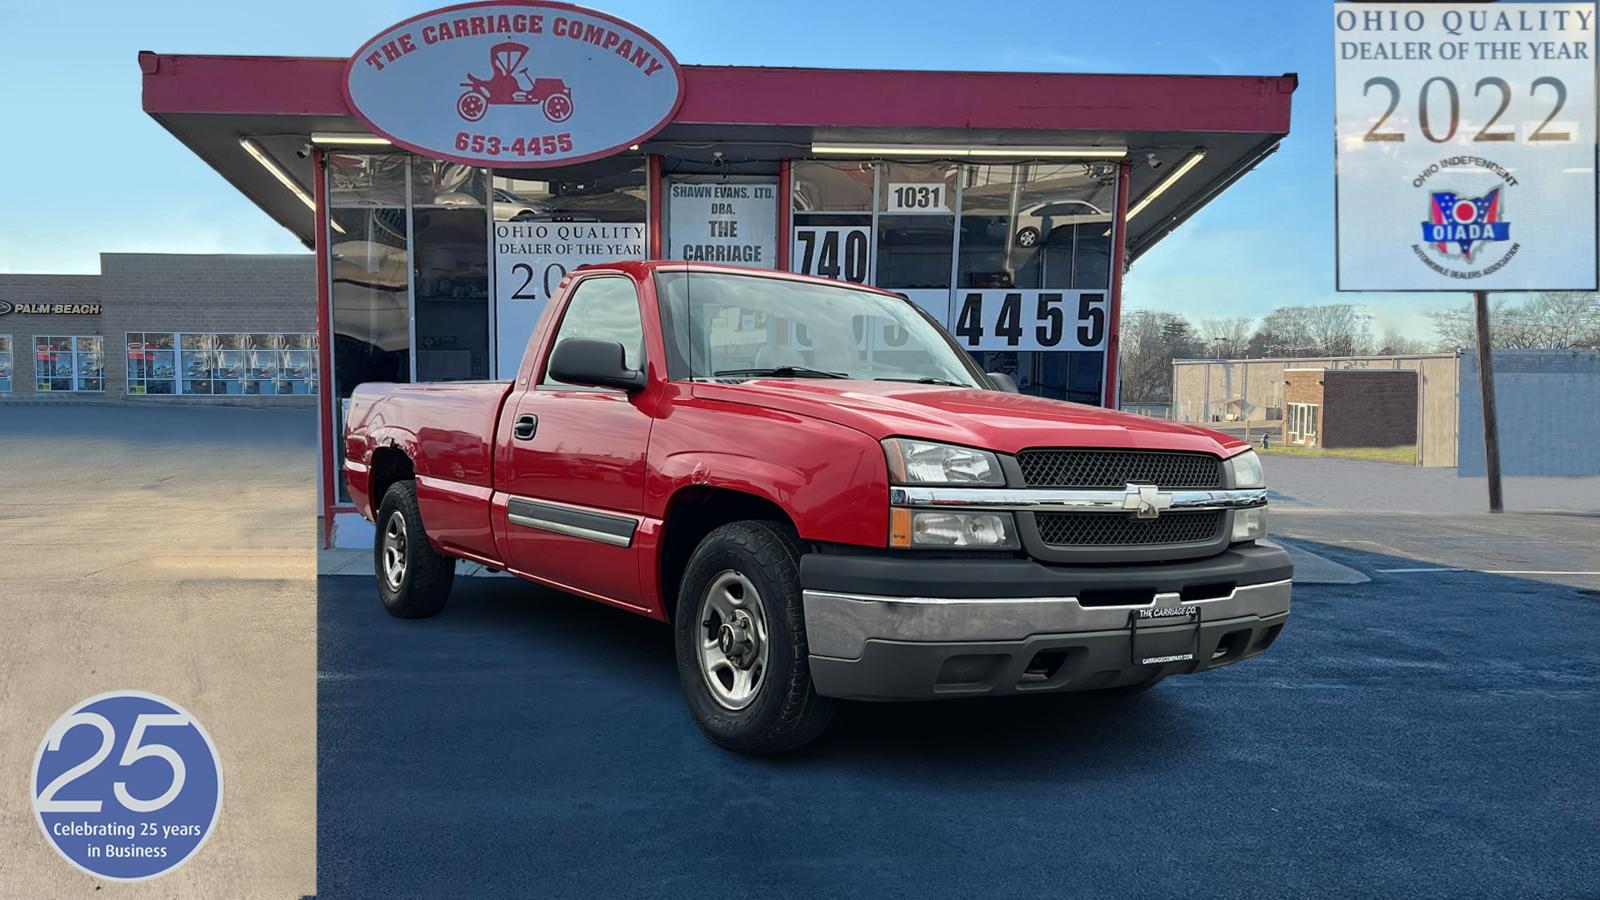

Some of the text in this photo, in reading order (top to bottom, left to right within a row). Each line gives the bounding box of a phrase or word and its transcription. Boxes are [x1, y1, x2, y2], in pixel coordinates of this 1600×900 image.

[1336, 9, 1592, 36] OHIO QUALITY
[365, 13, 664, 77] THE CARRIAGE COMPANY
[1340, 41, 1589, 60] DEALER OF THE YEAR
[1362, 76, 1572, 144] 2022
[454, 131, 573, 156] 653-4455
[1412, 155, 1519, 188] OHIO INDEPENDENT
[672, 186, 712, 199] SHAWN
[754, 186, 775, 199] LTD.
[893, 186, 940, 209] 1031
[711, 203, 736, 215] DBA.
[496, 225, 645, 241] OHIO QUALITY
[708, 220, 738, 238] THE
[1432, 224, 1495, 241] OIADA
[499, 243, 642, 255] DEALER OF THE YEAR
[683, 244, 762, 262] CARRIAGE
[797, 230, 868, 285] 740
[1450, 269, 1482, 280] DEALERS
[15, 303, 100, 314] PALM BEACH
[956, 292, 1106, 348] 4455
[1139, 608, 1153, 618] THE
[1153, 606, 1186, 617] CARRIAGE
